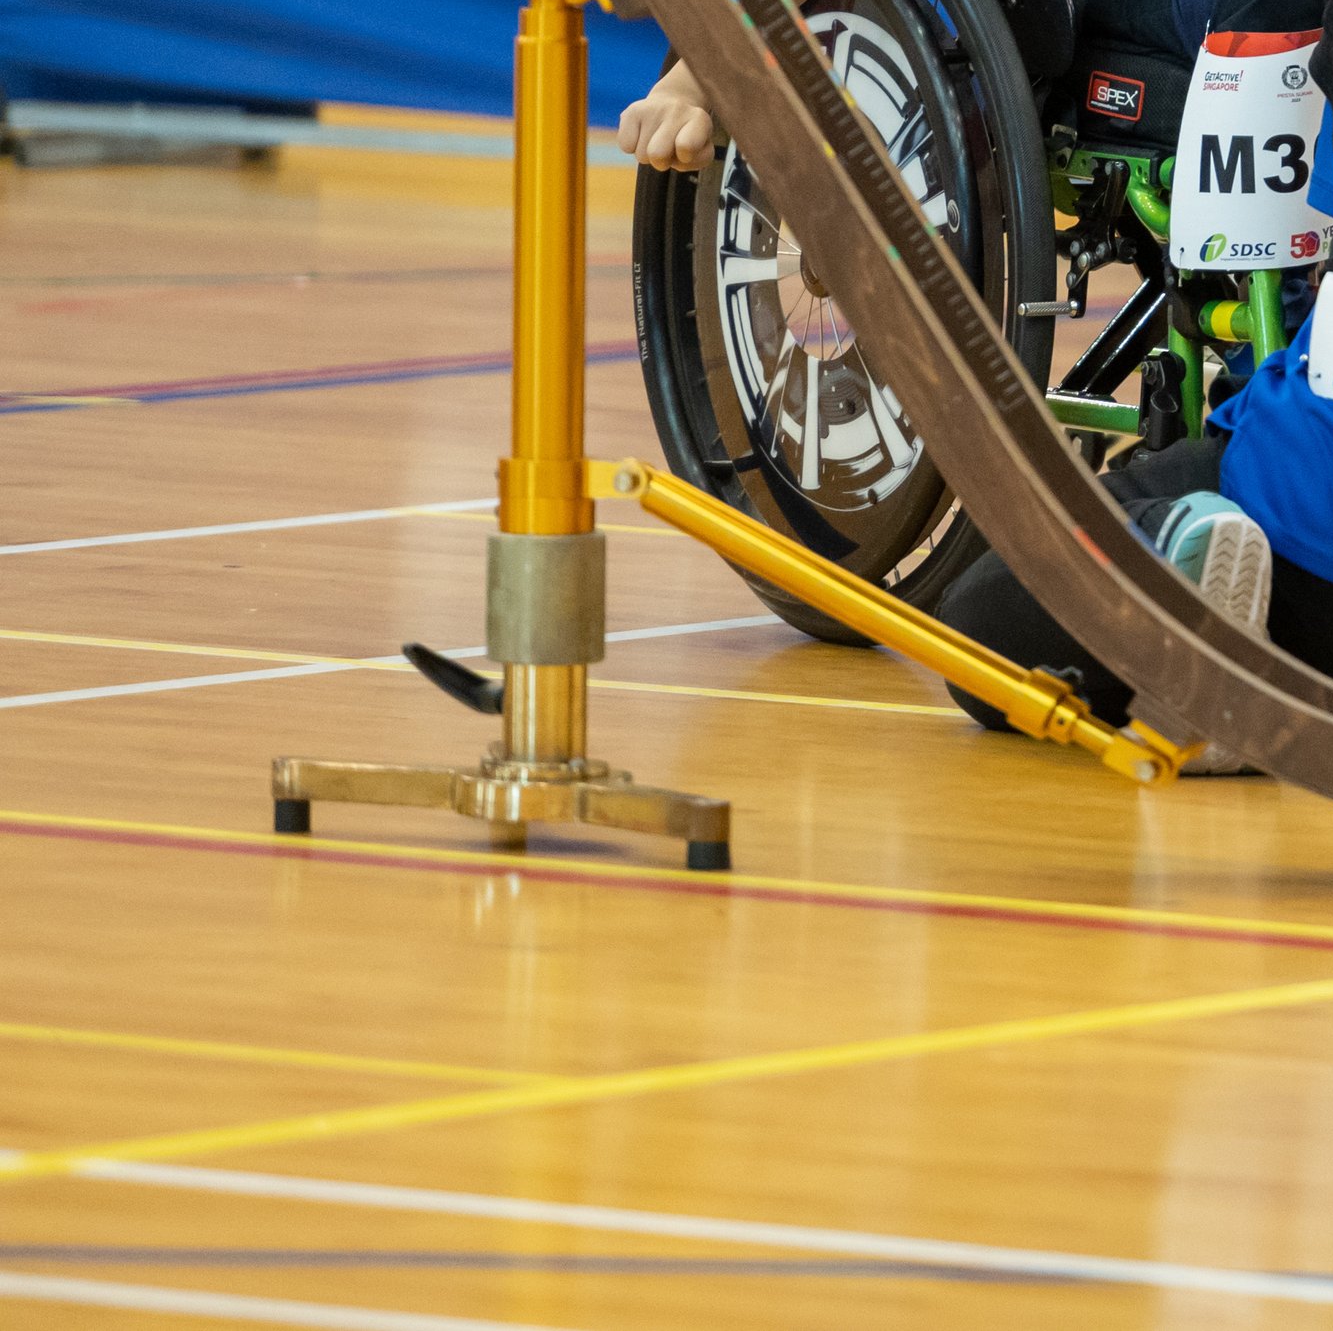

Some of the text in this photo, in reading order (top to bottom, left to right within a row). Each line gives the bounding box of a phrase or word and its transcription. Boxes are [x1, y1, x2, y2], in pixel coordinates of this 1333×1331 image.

[1097, 85, 1139, 108] SPEX
[1203, 82, 1239, 91] SINGAPORE
[1199, 133, 1320, 194] M3
[1230, 242, 1276, 257] SDSC
[641, 339, 649, 363] The
